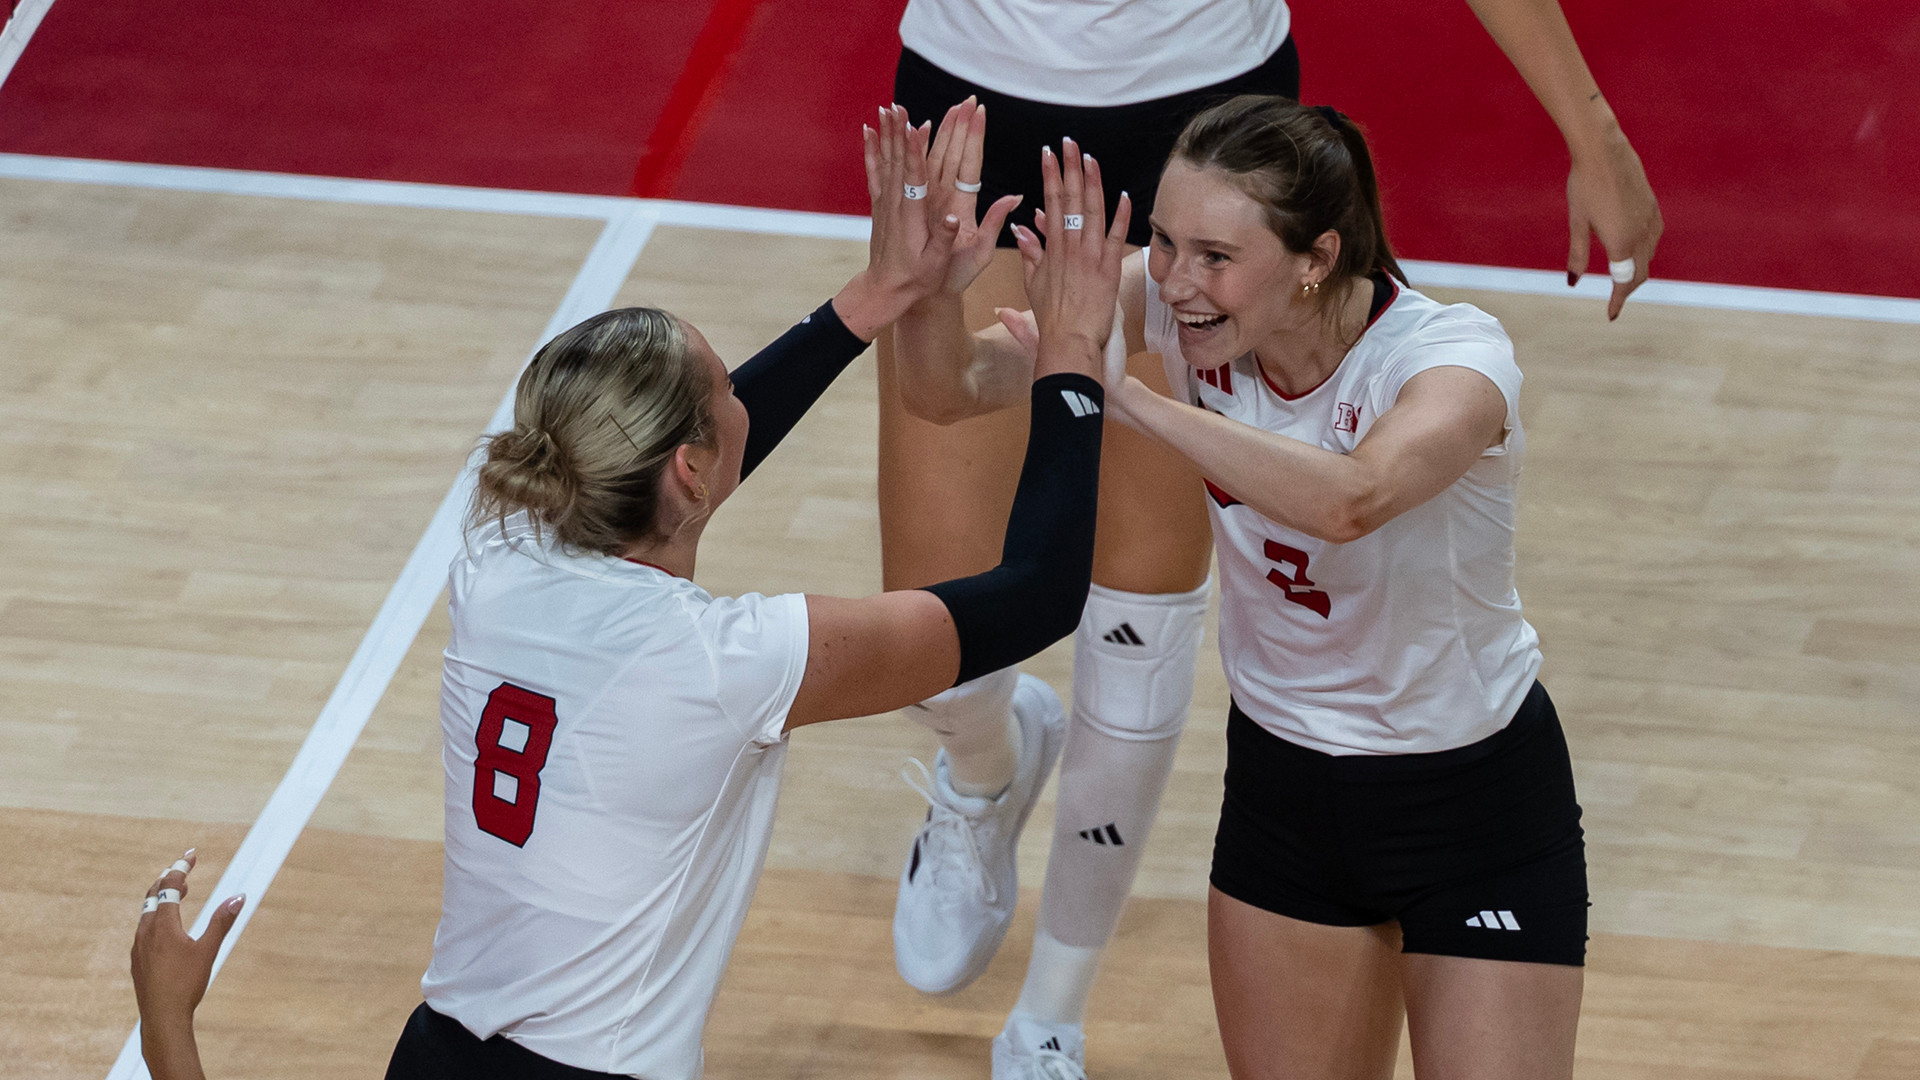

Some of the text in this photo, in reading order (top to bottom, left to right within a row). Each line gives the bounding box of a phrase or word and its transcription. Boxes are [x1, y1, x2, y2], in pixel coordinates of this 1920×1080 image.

[1064, 216, 1079, 228] KC
[1264, 538, 1331, 620] 2
[472, 681, 558, 848] 8
